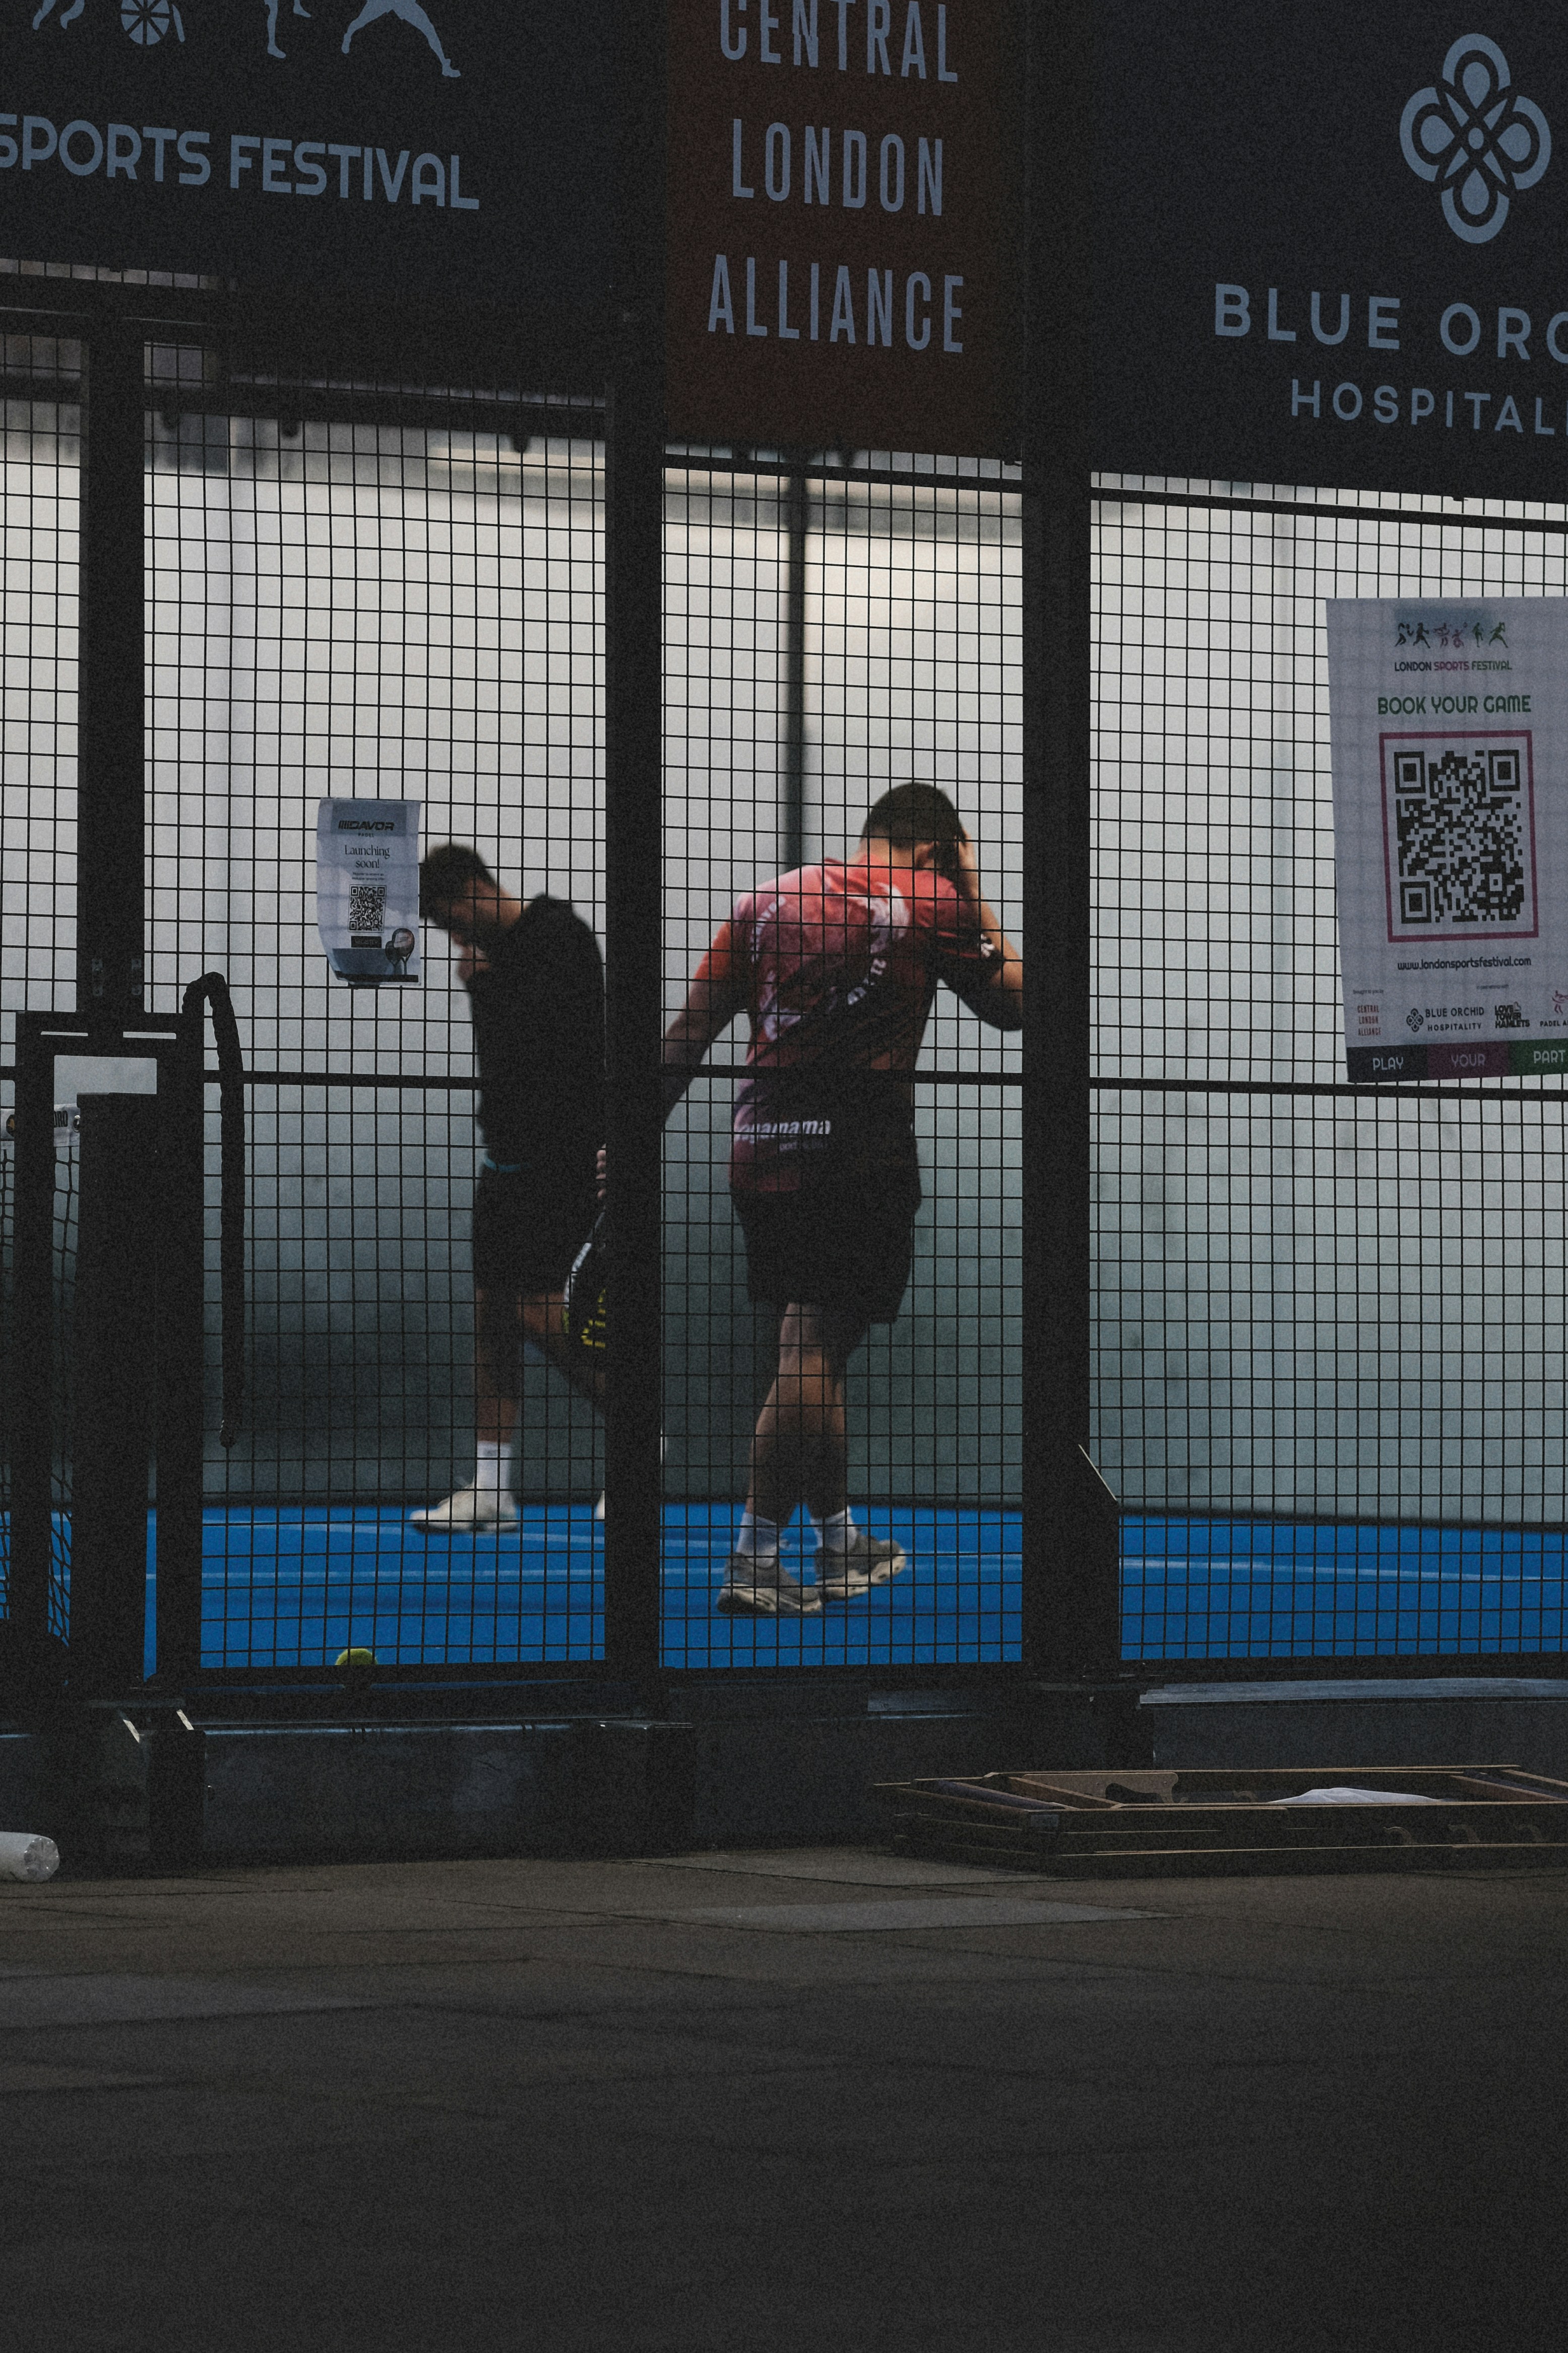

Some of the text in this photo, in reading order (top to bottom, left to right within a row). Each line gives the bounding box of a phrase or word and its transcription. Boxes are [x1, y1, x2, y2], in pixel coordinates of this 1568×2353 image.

[720, 0, 957, 82] CENTRAL
[230, 135, 479, 210] FESTIVAL
[733, 118, 942, 216] LONDON
[708, 254, 963, 353] ALLIANCE
[1215, 283, 1400, 349] BLUE
[1395, 660, 1512, 671] LONDON SPORTS FESTIVAL
[1378, 695, 1531, 714] BOOK YOUR GAME
[345, 844, 390, 859] Launching
[356, 859, 380, 868] soon!
[1398, 956, 1531, 971] www.londonsportsfestival.com
[1357, 1005, 1379, 1013] CENTRAL
[1425, 1007, 1484, 1017] BLUE ORCHID
[1494, 1005, 1514, 1013] LOVE
[1359, 1016, 1378, 1024] LONDON
[1495, 1012, 1521, 1020] TOWER
[1428, 1022, 1482, 1032] HOSPITALITY
[1495, 1019, 1530, 1028] HAMLETS
[1358, 1027, 1381, 1036] ALLIANCE
[1372, 1049, 1565, 1071] PLAY YOUR PART
